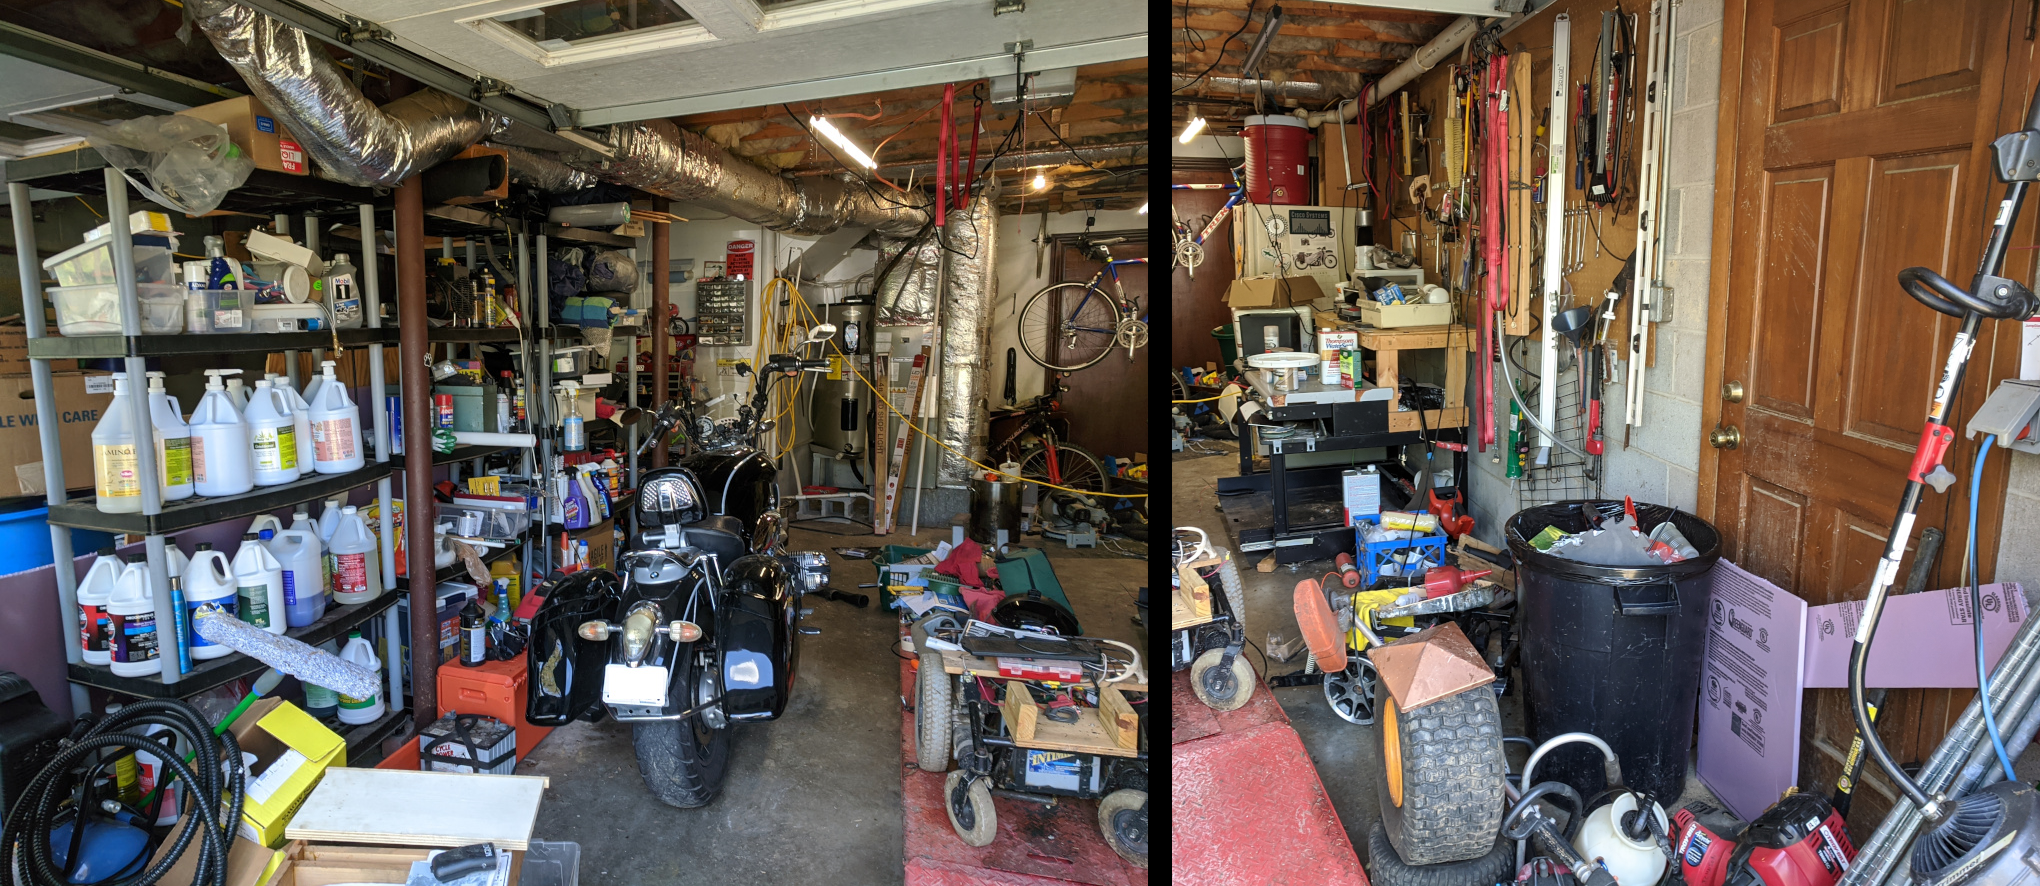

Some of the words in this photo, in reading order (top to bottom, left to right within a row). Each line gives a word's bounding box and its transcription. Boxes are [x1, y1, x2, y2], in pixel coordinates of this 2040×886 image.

[1203, 207, 1229, 235] TREK
[62, 409, 99, 424] CARE
[877, 411, 885, 432] SHOP
[876, 433, 885, 455] LIGHT
[1964, 594, 1972, 618] Insulate
[1984, 598, 1993, 607] UL
[1959, 607, 1967, 623] STAR
[435, 744, 451, 752] CYCLE
[1679, 823, 1697, 854] TROY-BILT
